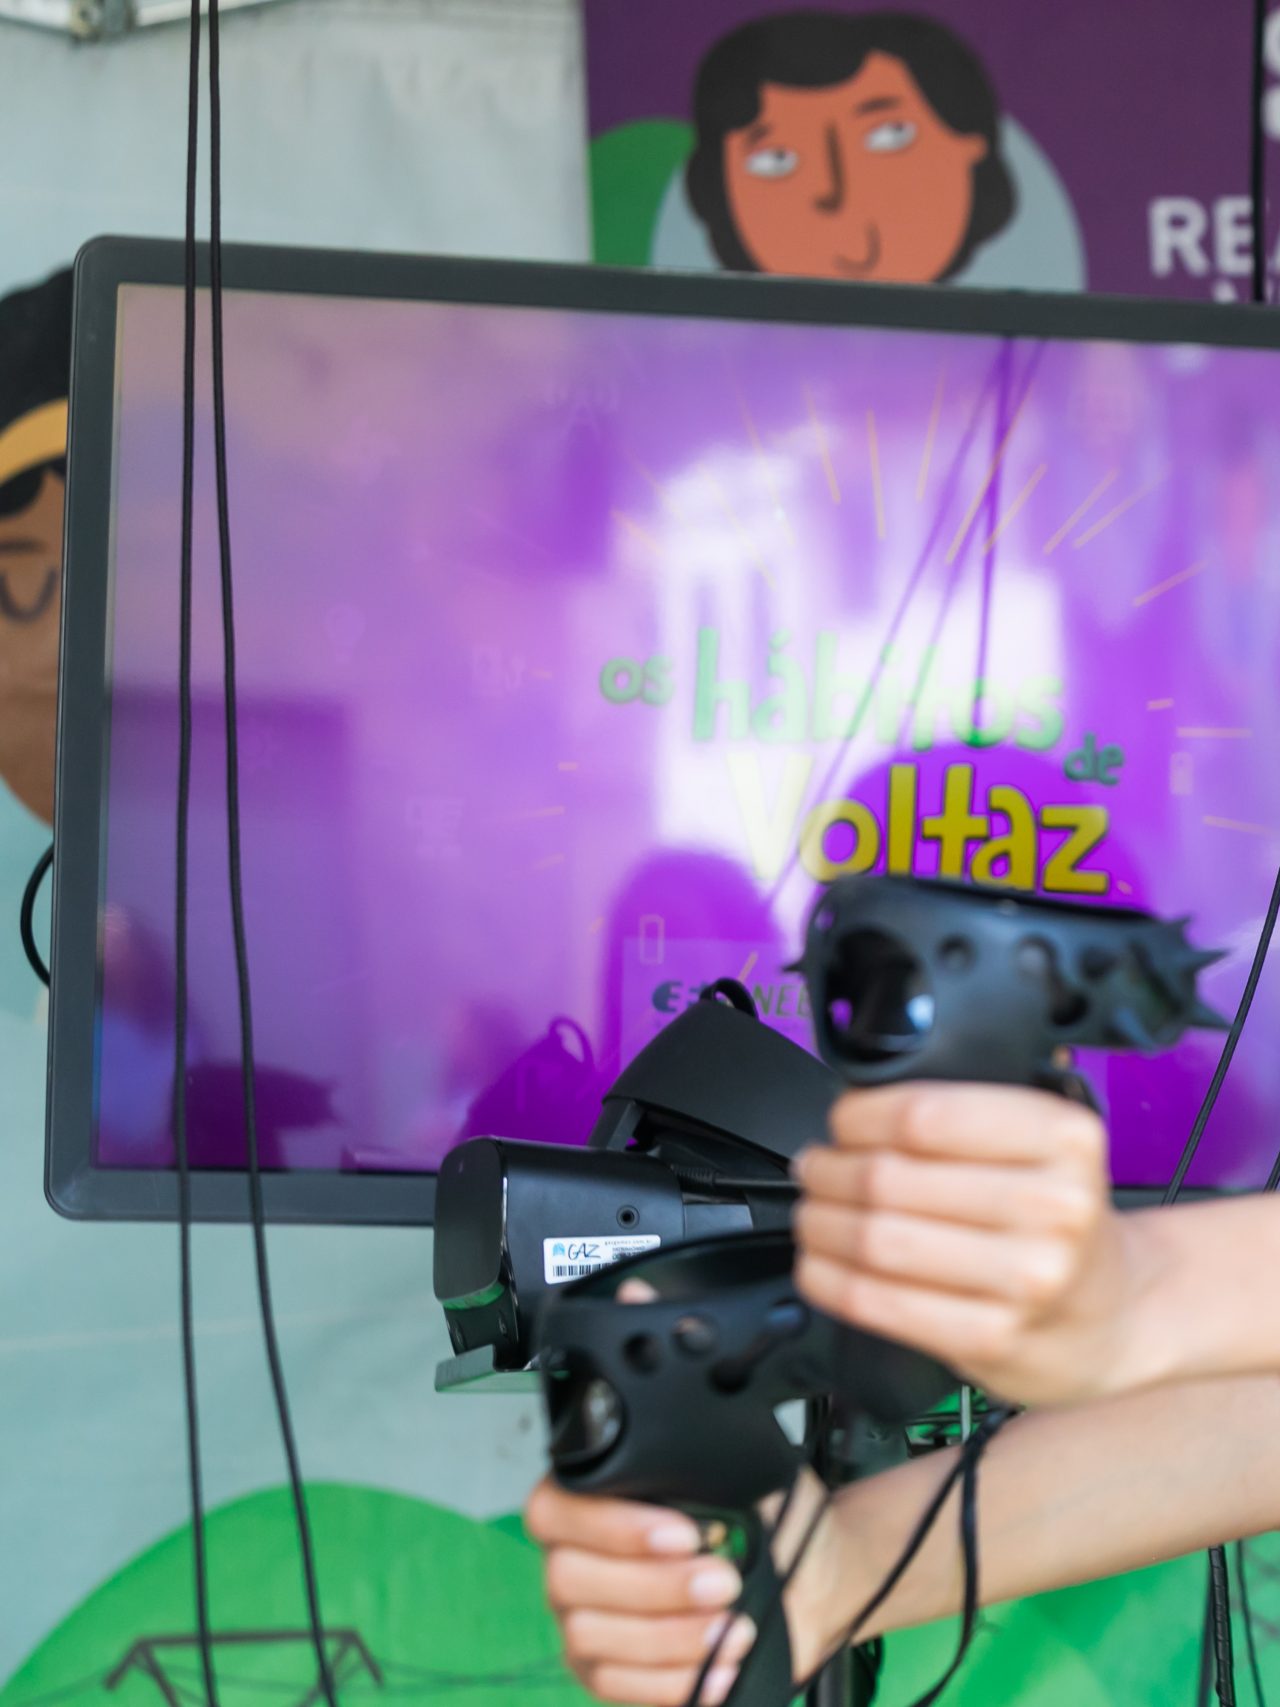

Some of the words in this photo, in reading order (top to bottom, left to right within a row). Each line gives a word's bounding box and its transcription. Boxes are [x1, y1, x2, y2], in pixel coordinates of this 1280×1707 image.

[600, 657, 674, 705] os
[1063, 732, 1125, 786] de
[725, 753, 1110, 895] Voltaz
[568, 1242, 601, 1260] GAZ
